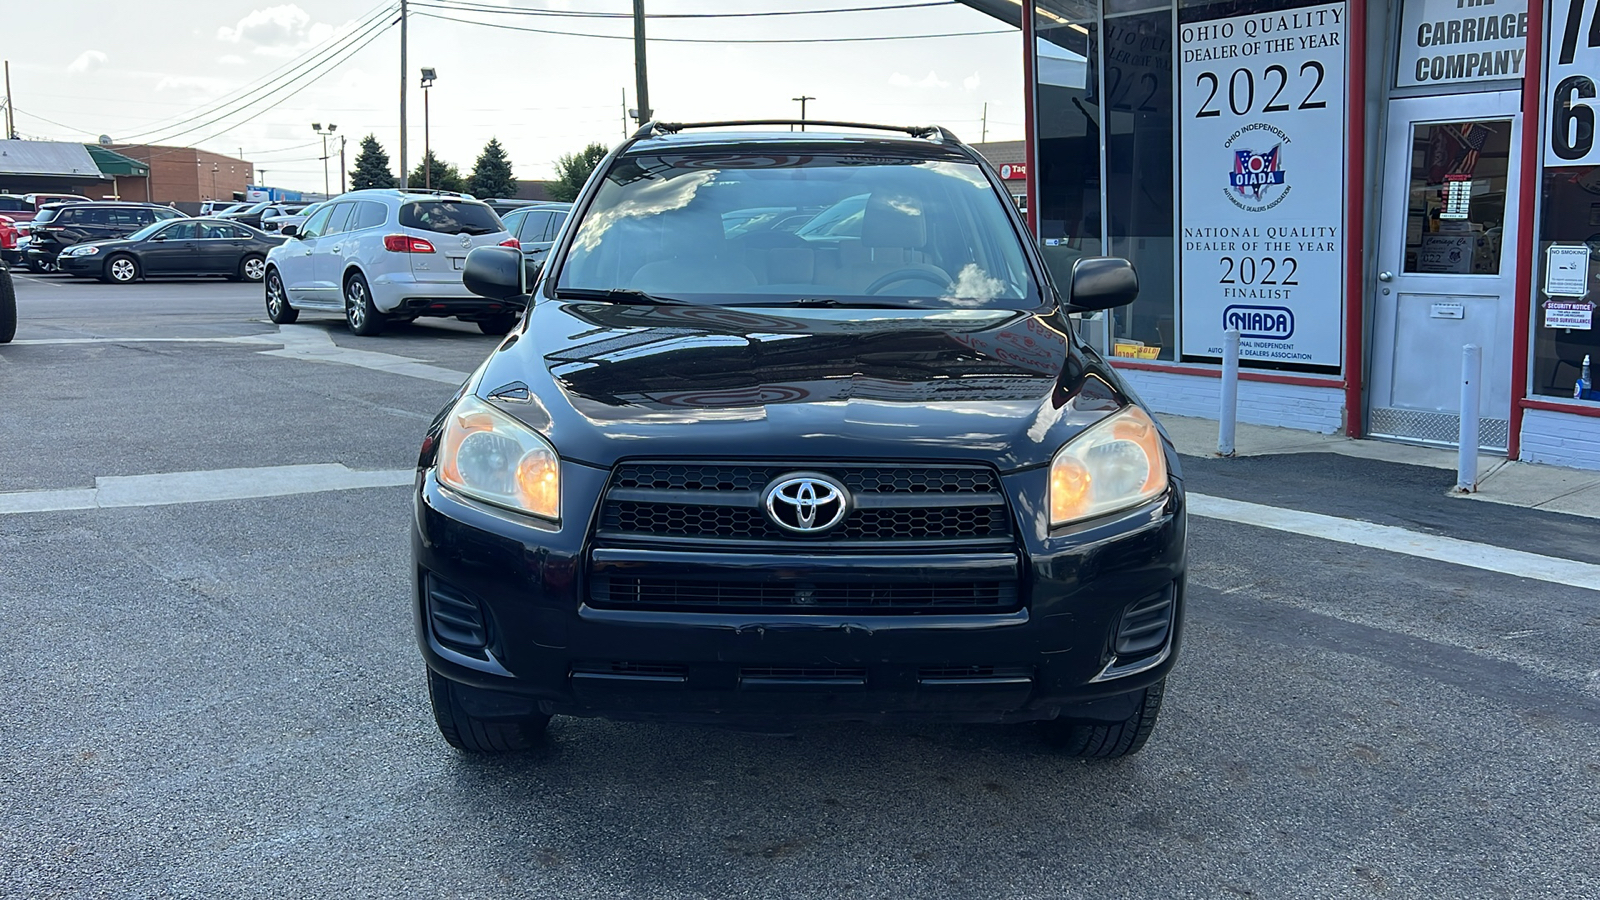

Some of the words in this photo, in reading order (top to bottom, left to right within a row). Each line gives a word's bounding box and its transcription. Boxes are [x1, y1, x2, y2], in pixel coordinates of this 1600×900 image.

[1182, 23, 1234, 44] OHIO
[1244, 8, 1343, 37] QUALITY
[1417, 12, 1528, 47] CARRIAGE
[1184, 44, 1238, 62] DEALER
[1242, 41, 1261, 56] OF
[1264, 38, 1295, 53] THE
[1298, 32, 1340, 49] YEAR
[1415, 49, 1525, 81] COMPANY
[1195, 60, 1326, 118] 2022
[1224, 130, 1240, 148] OHIO
[1241, 123, 1292, 144] INDEPENDENT
[1236, 172, 1276, 185] OIADA
[1223, 188, 1246, 210] AUTOMOBILE
[1266, 185, 1292, 210] ASSOCIATION
[1184, 227, 1260, 238] NATIONAL
[1267, 227, 1337, 239] QUALITY
[1186, 242, 1236, 250] DEALER
[1242, 242, 1258, 251] OF
[1264, 242, 1291, 251] THE
[1298, 242, 1335, 251] YEAR
[1219, 256, 1298, 286] 2022
[1224, 288, 1291, 299] FINALIST
[1229, 312, 1287, 332] NIADA
[1254, 342, 1294, 350] INDEPENDENT
[1271, 352, 1312, 360] ASSOCIATION
